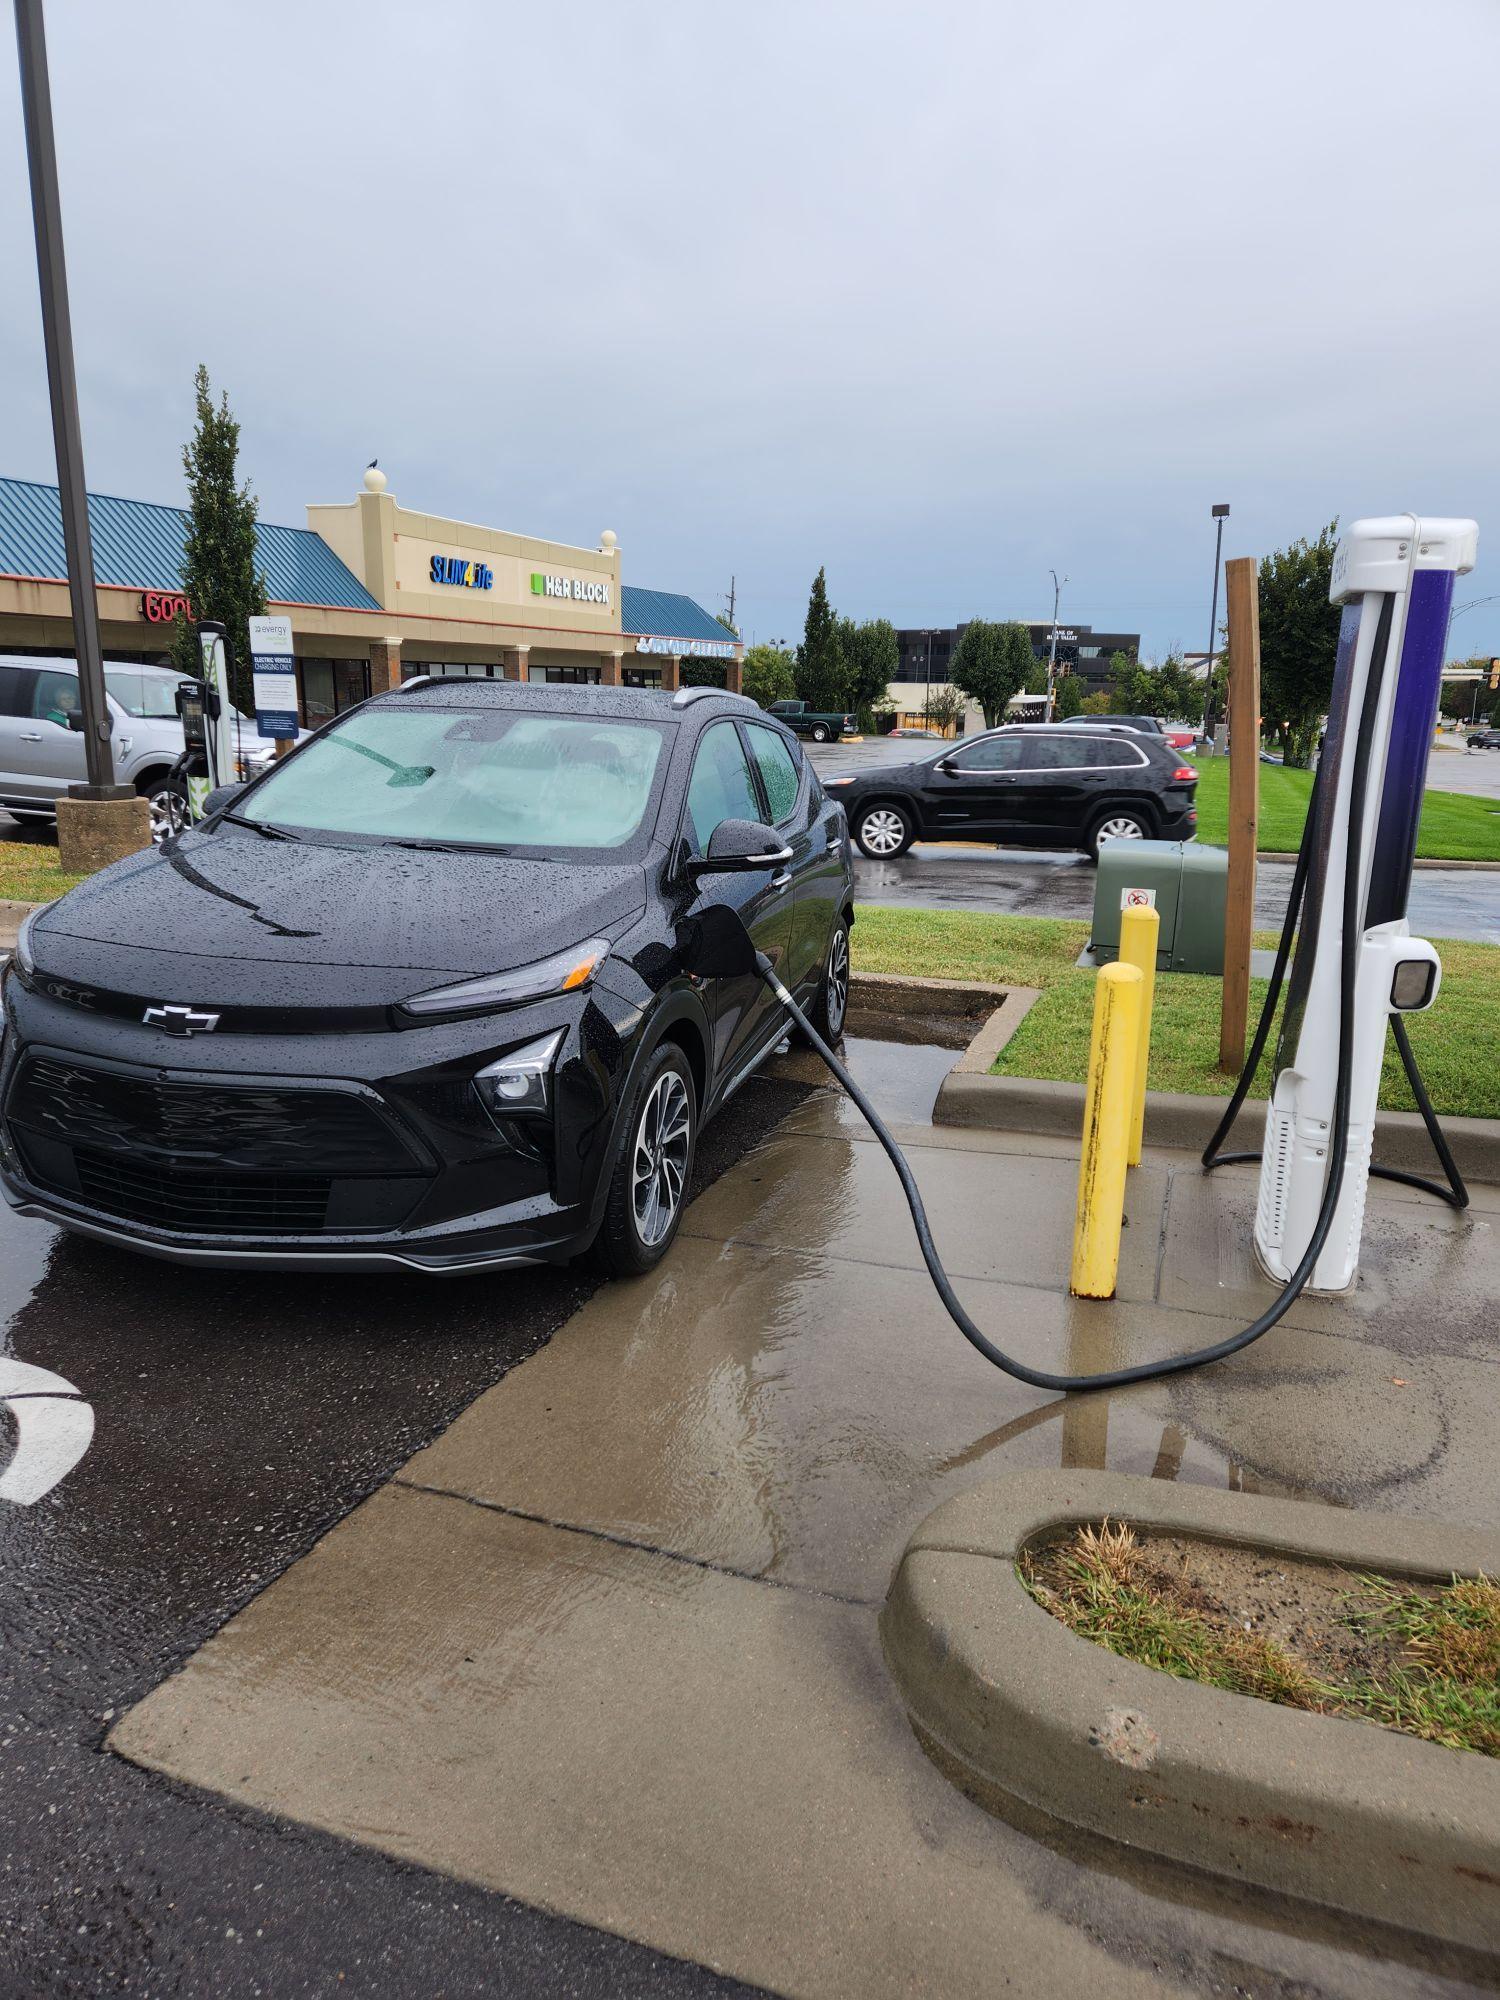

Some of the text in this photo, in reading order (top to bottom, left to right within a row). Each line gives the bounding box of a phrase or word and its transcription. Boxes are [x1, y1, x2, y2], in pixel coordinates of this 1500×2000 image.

[544, 575, 609, 603] H&R BLOCK
[262, 625, 287, 636] evergy
[254, 663, 279, 671] CHARGING
